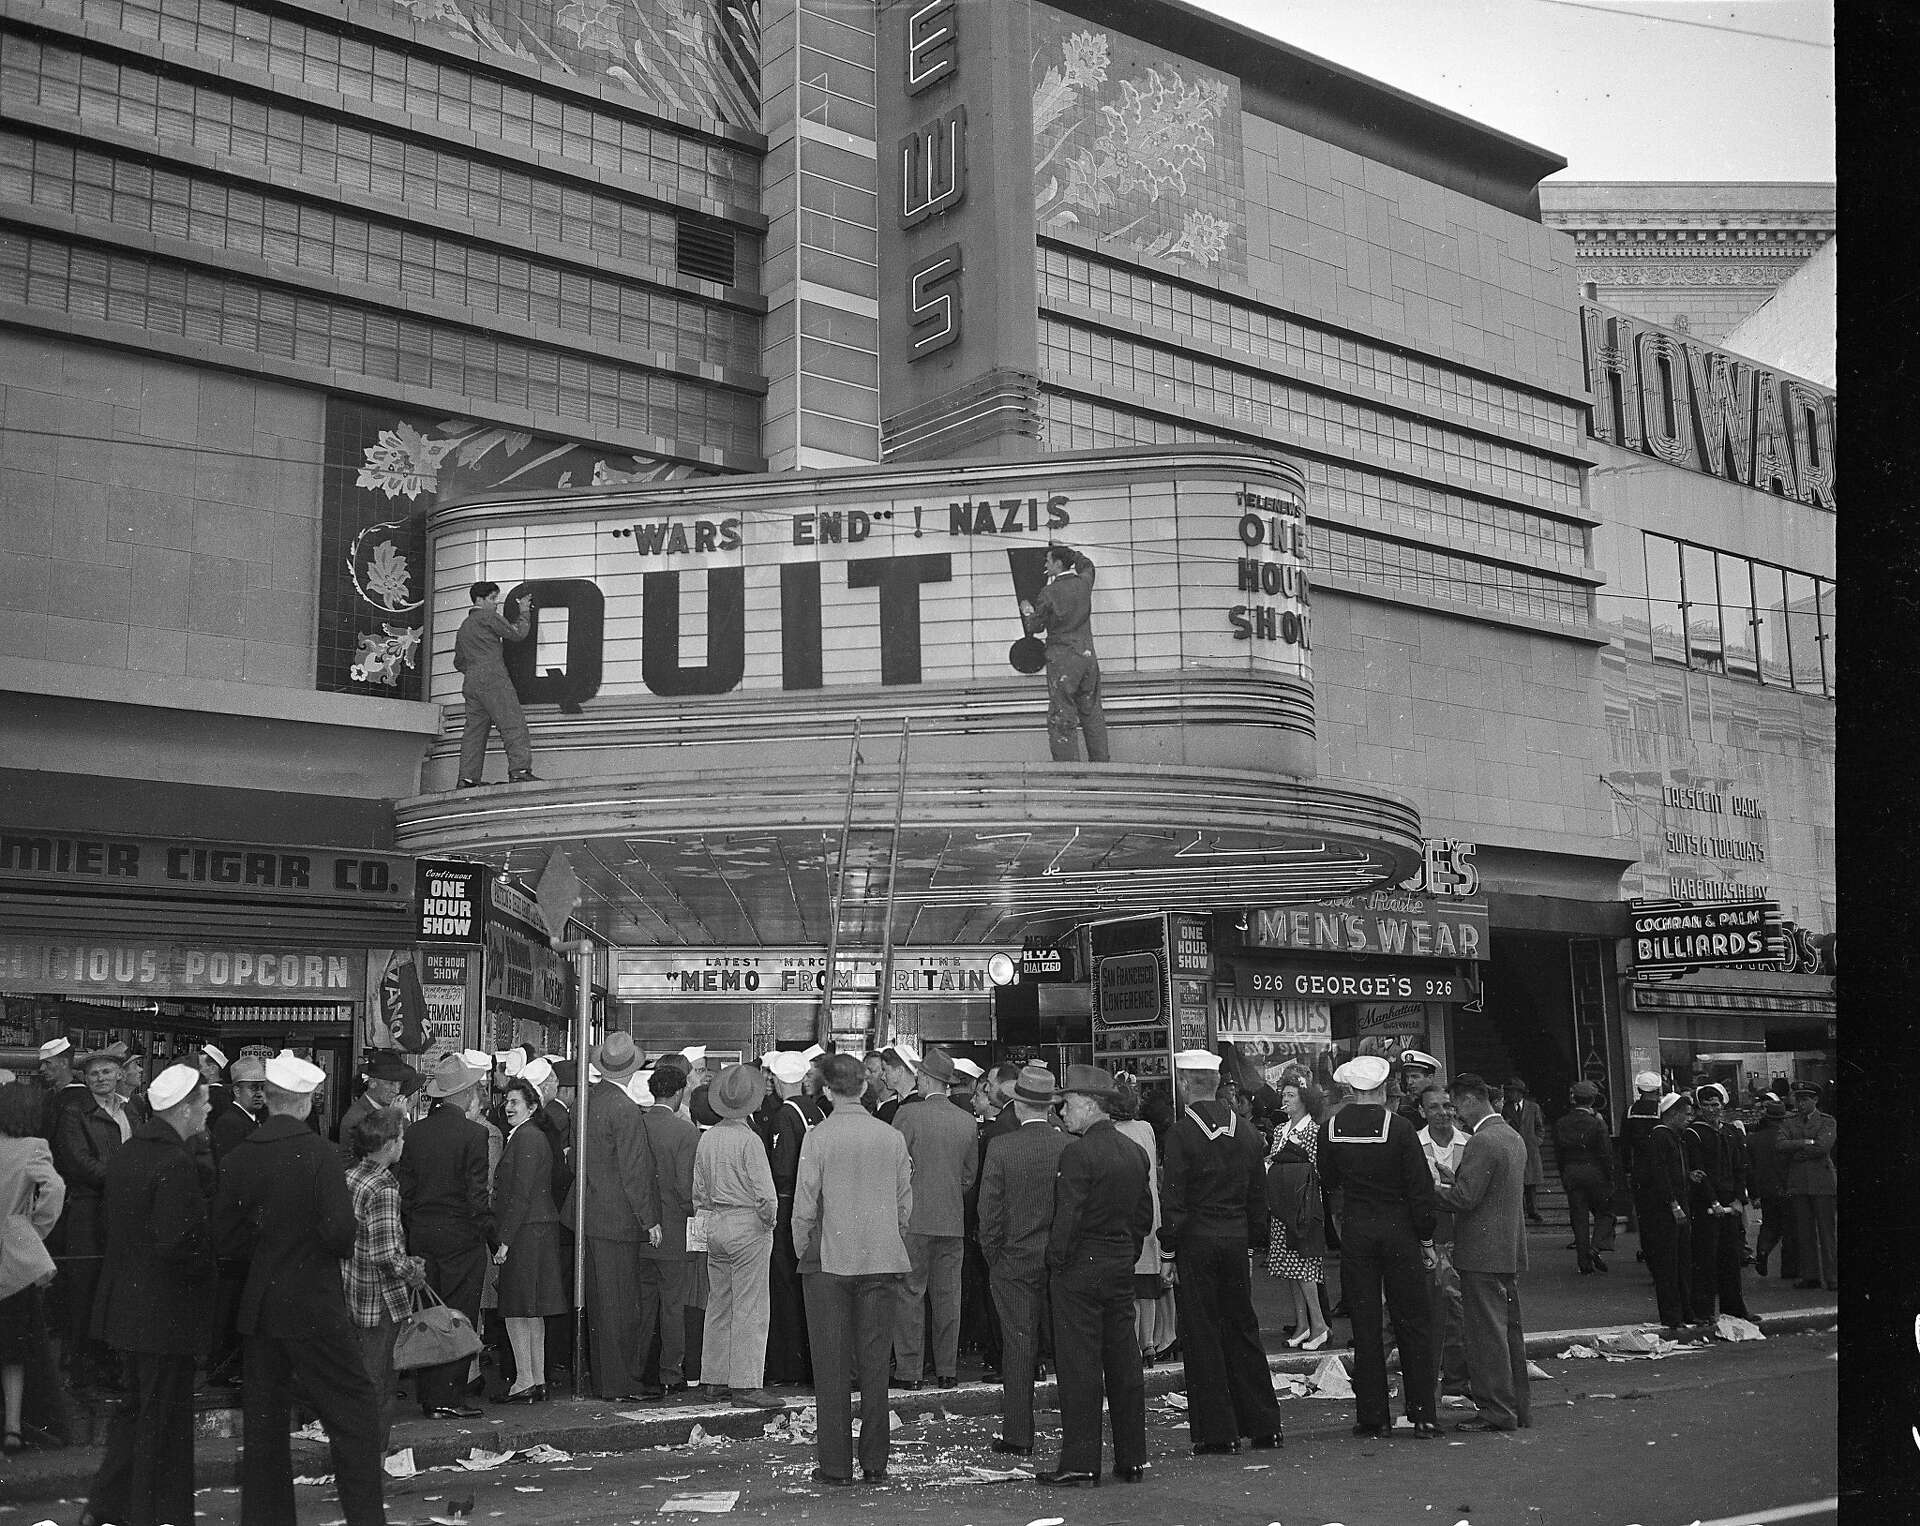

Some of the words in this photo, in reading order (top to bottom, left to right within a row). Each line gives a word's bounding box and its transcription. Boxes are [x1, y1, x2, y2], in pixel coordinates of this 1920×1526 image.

[1580, 305, 1836, 514] HOWAR
[1236, 491, 1303, 518] TELENEWS
[949, 495, 1071, 536] NAZIS
[1239, 513, 1306, 560] ONE
[1238, 556, 1312, 607] HOUR
[1228, 604, 1313, 651] SHOW
[1732, 795, 1763, 820] PARK
[1666, 831, 1698, 856] SUITS
[1711, 837, 1765, 863] TOPCOATS
[166, 846, 311, 890] CIGAR
[334, 859, 400, 893] CO.
[425, 868, 473, 880] Continuous
[431, 879, 465, 898] ONE
[423, 898, 472, 917] HOUR
[422, 917, 472, 936] SHOW
[1635, 914, 1702, 933] COCHRAN
[1704, 914, 1716, 928] &
[1719, 910, 1760, 926] PALM
[1181, 926, 1203, 940] ONE
[1257, 909, 1368, 950] MEN'S
[1375, 915, 1480, 959] WEAR
[1177, 940, 1208, 955] HOUR
[1637, 930, 1763, 960] BILLIARDS
[186, 952, 348, 988] POPCORN
[427, 956, 444, 967] ONE
[445, 957, 466, 968] HOUR
[705, 957, 760, 967] LATEST
[784, 957, 825, 967] MARC
[919, 957, 961, 966] TIME
[1023, 962, 1042, 974] DIAL
[1178, 955, 1208, 969] SHOW
[433, 968, 460, 980] SHOW
[781, 970, 852, 991] FROM
[1117, 965, 1154, 985] FRANCISCO
[1253, 974, 1283, 991] 926
[1295, 974, 1412, 996] GEORGE'S
[1425, 979, 1452, 996] 926
[1103, 990, 1155, 1011] CONFERENCE
[426, 1003, 461, 1022] ERMANY
[1217, 1000, 1265, 1032] NAVY
[1273, 1000, 1328, 1033] BLUES
[1359, 1003, 1422, 1030] Manhattan
[431, 1023, 461, 1038] UMBLES
